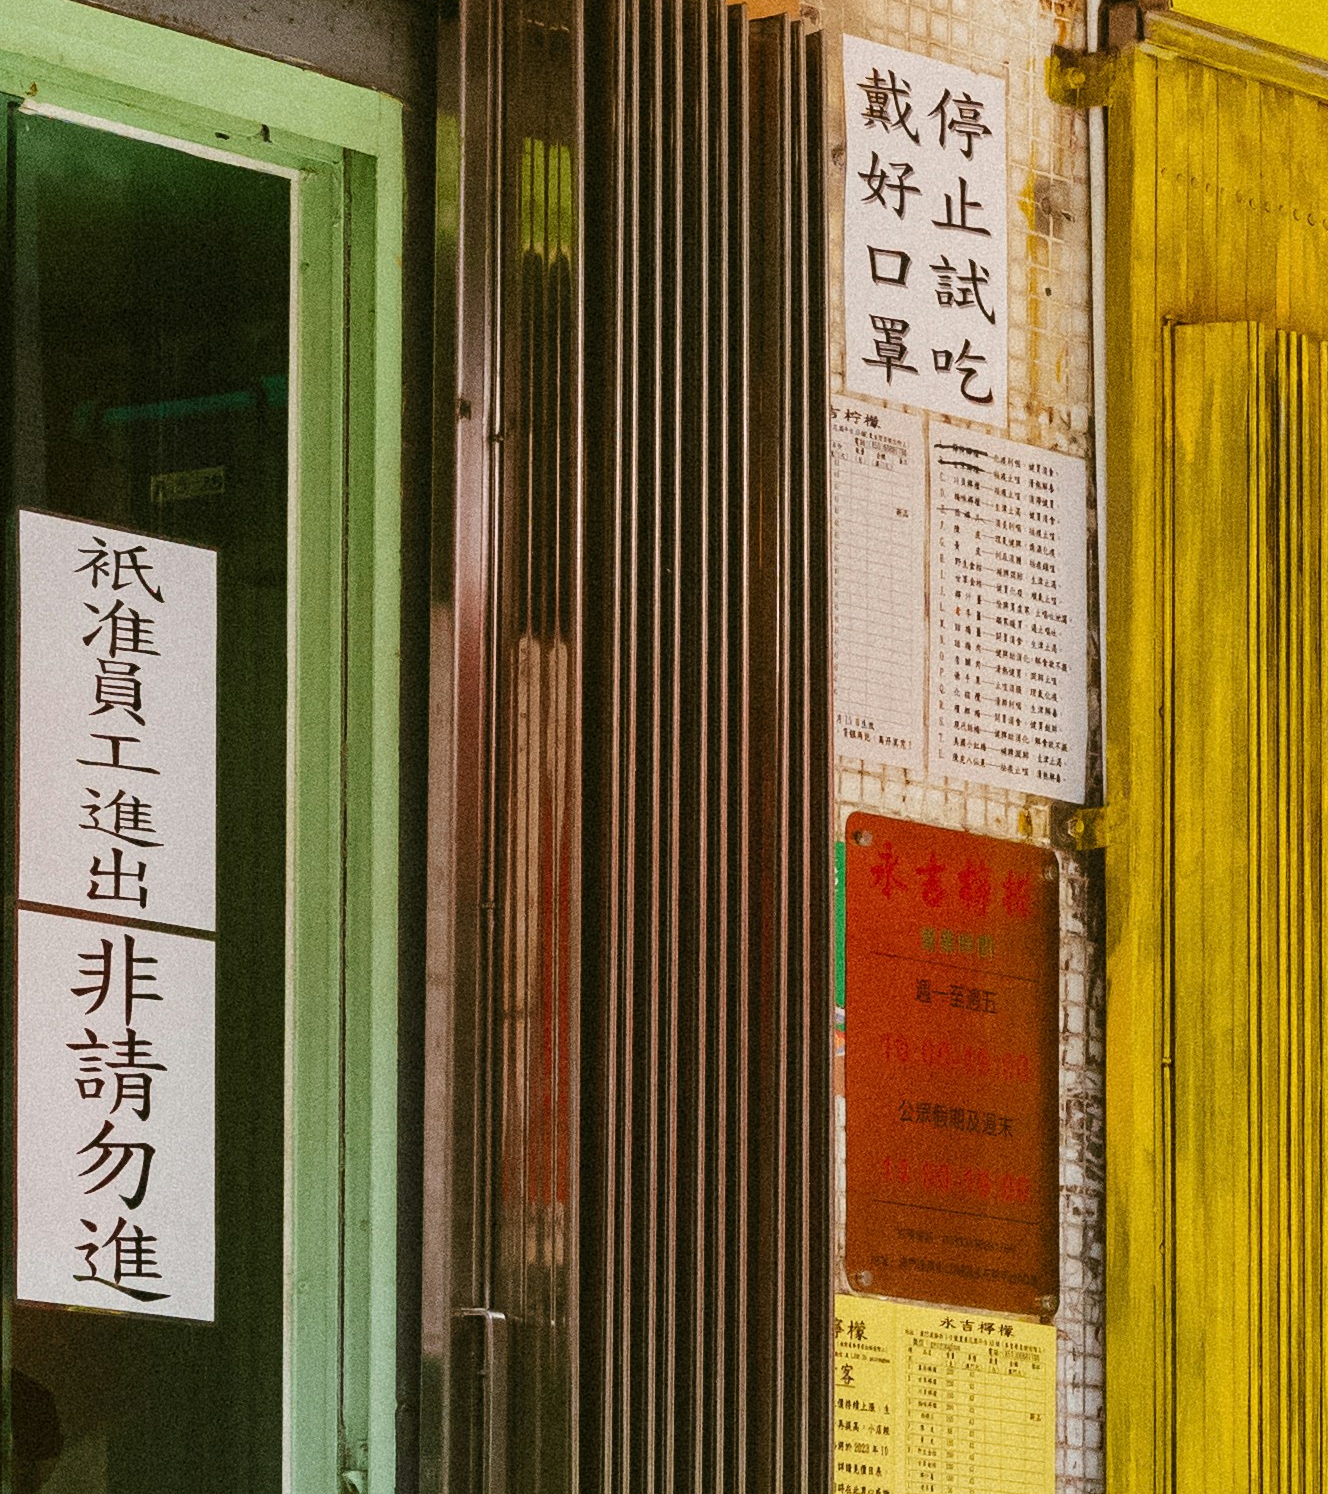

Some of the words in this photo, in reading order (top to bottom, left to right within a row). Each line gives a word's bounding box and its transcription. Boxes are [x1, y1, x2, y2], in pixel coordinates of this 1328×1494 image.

[859, 70, 922, 381] 戴好口罩
[929, 88, 996, 404] 停止試吃
[870, 841, 1033, 920] 永吉檸檬
[70, 933, 170, 1303] 非請勿進
